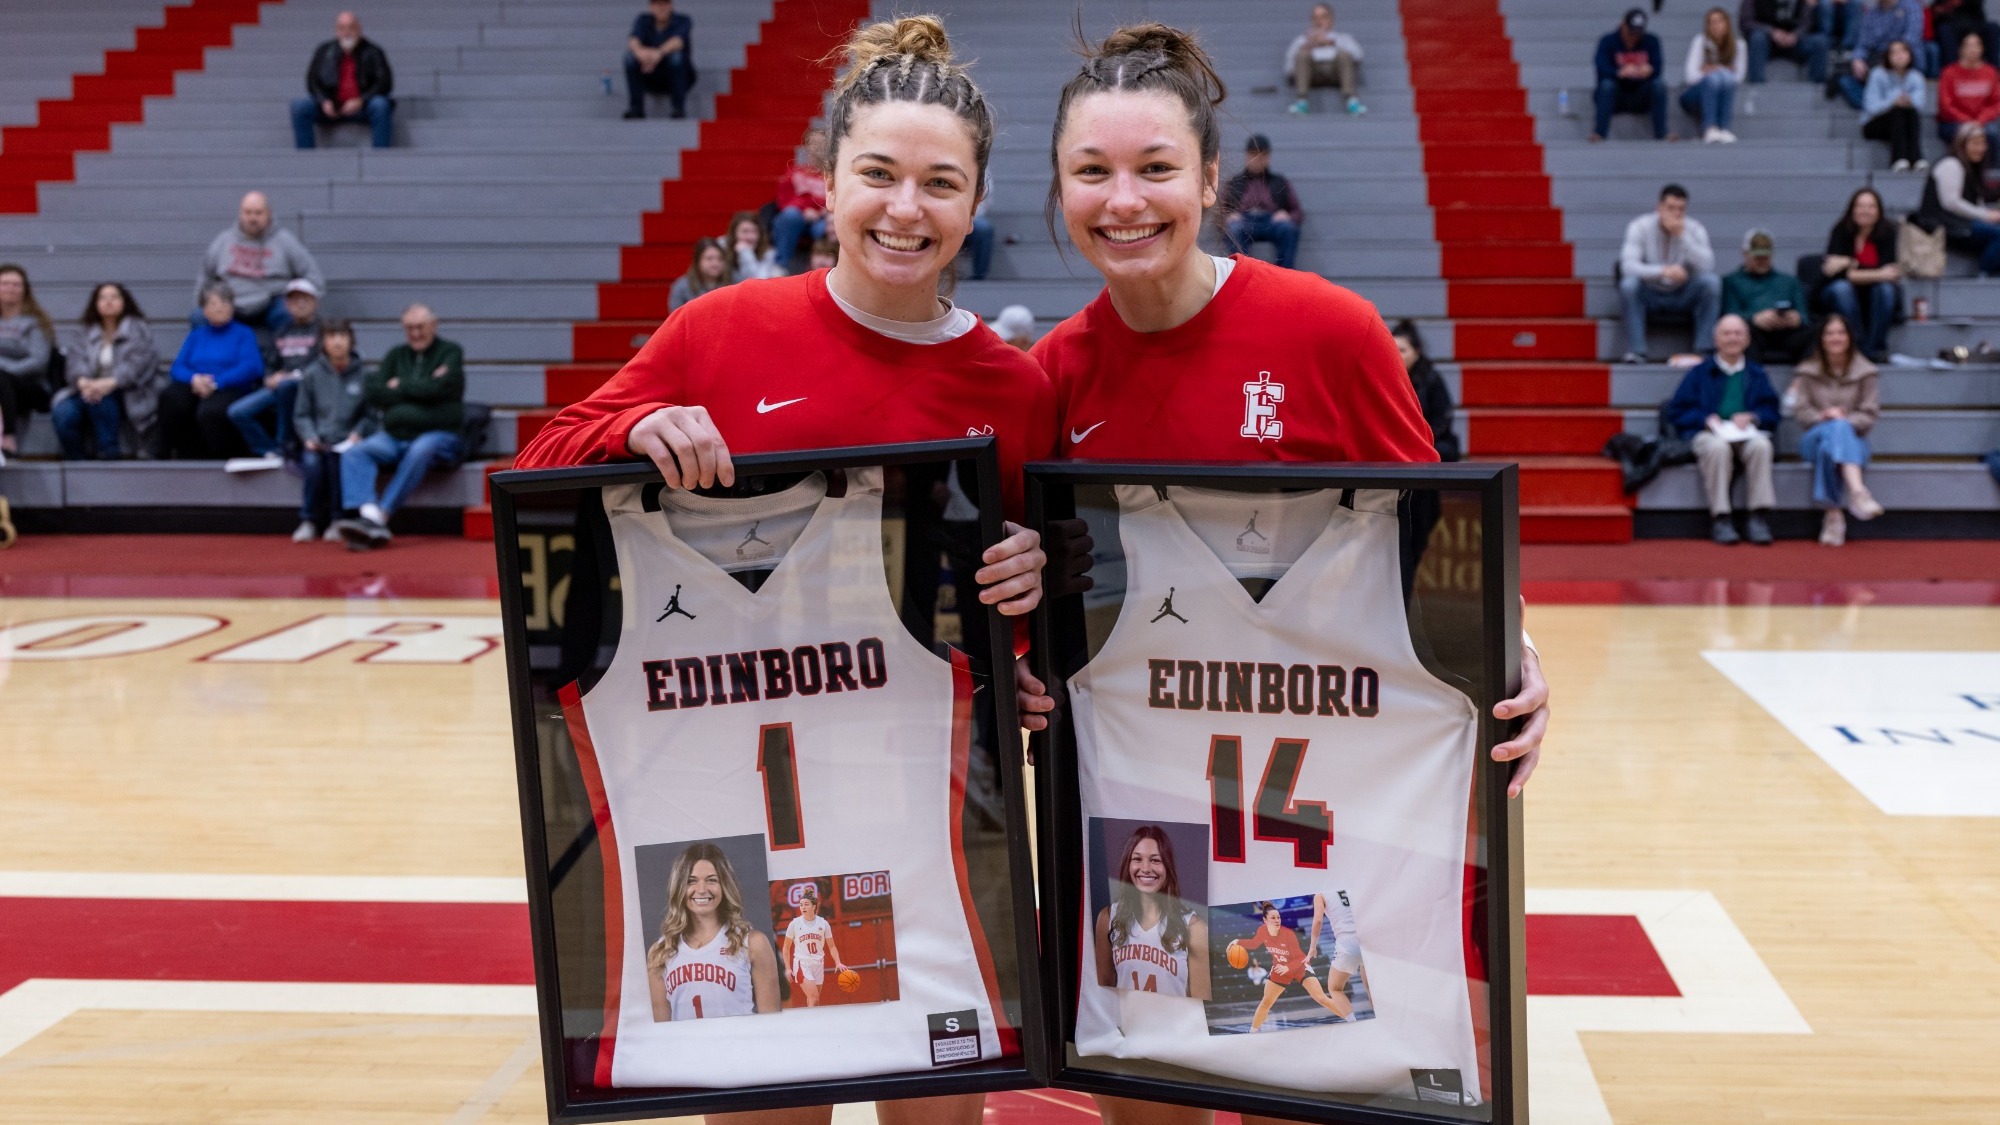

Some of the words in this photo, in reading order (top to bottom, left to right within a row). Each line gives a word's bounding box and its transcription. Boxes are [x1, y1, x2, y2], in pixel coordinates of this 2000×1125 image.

[1241, 371, 1285, 442] E
[642, 637, 888, 712] EDINBORO
[1148, 658, 1380, 718] EDINBORO
[756, 721, 805, 851] 1
[1205, 734, 1334, 869] 14
[844, 872, 891, 900] BOR
[1338, 890, 1350, 907] 5
[807, 942, 818, 954] 10
[1114, 944, 1178, 976] EDINBORO
[692, 995, 704, 1018] 1
[945, 1017, 960, 1033] S
[1429, 1073, 1442, 1087] L
